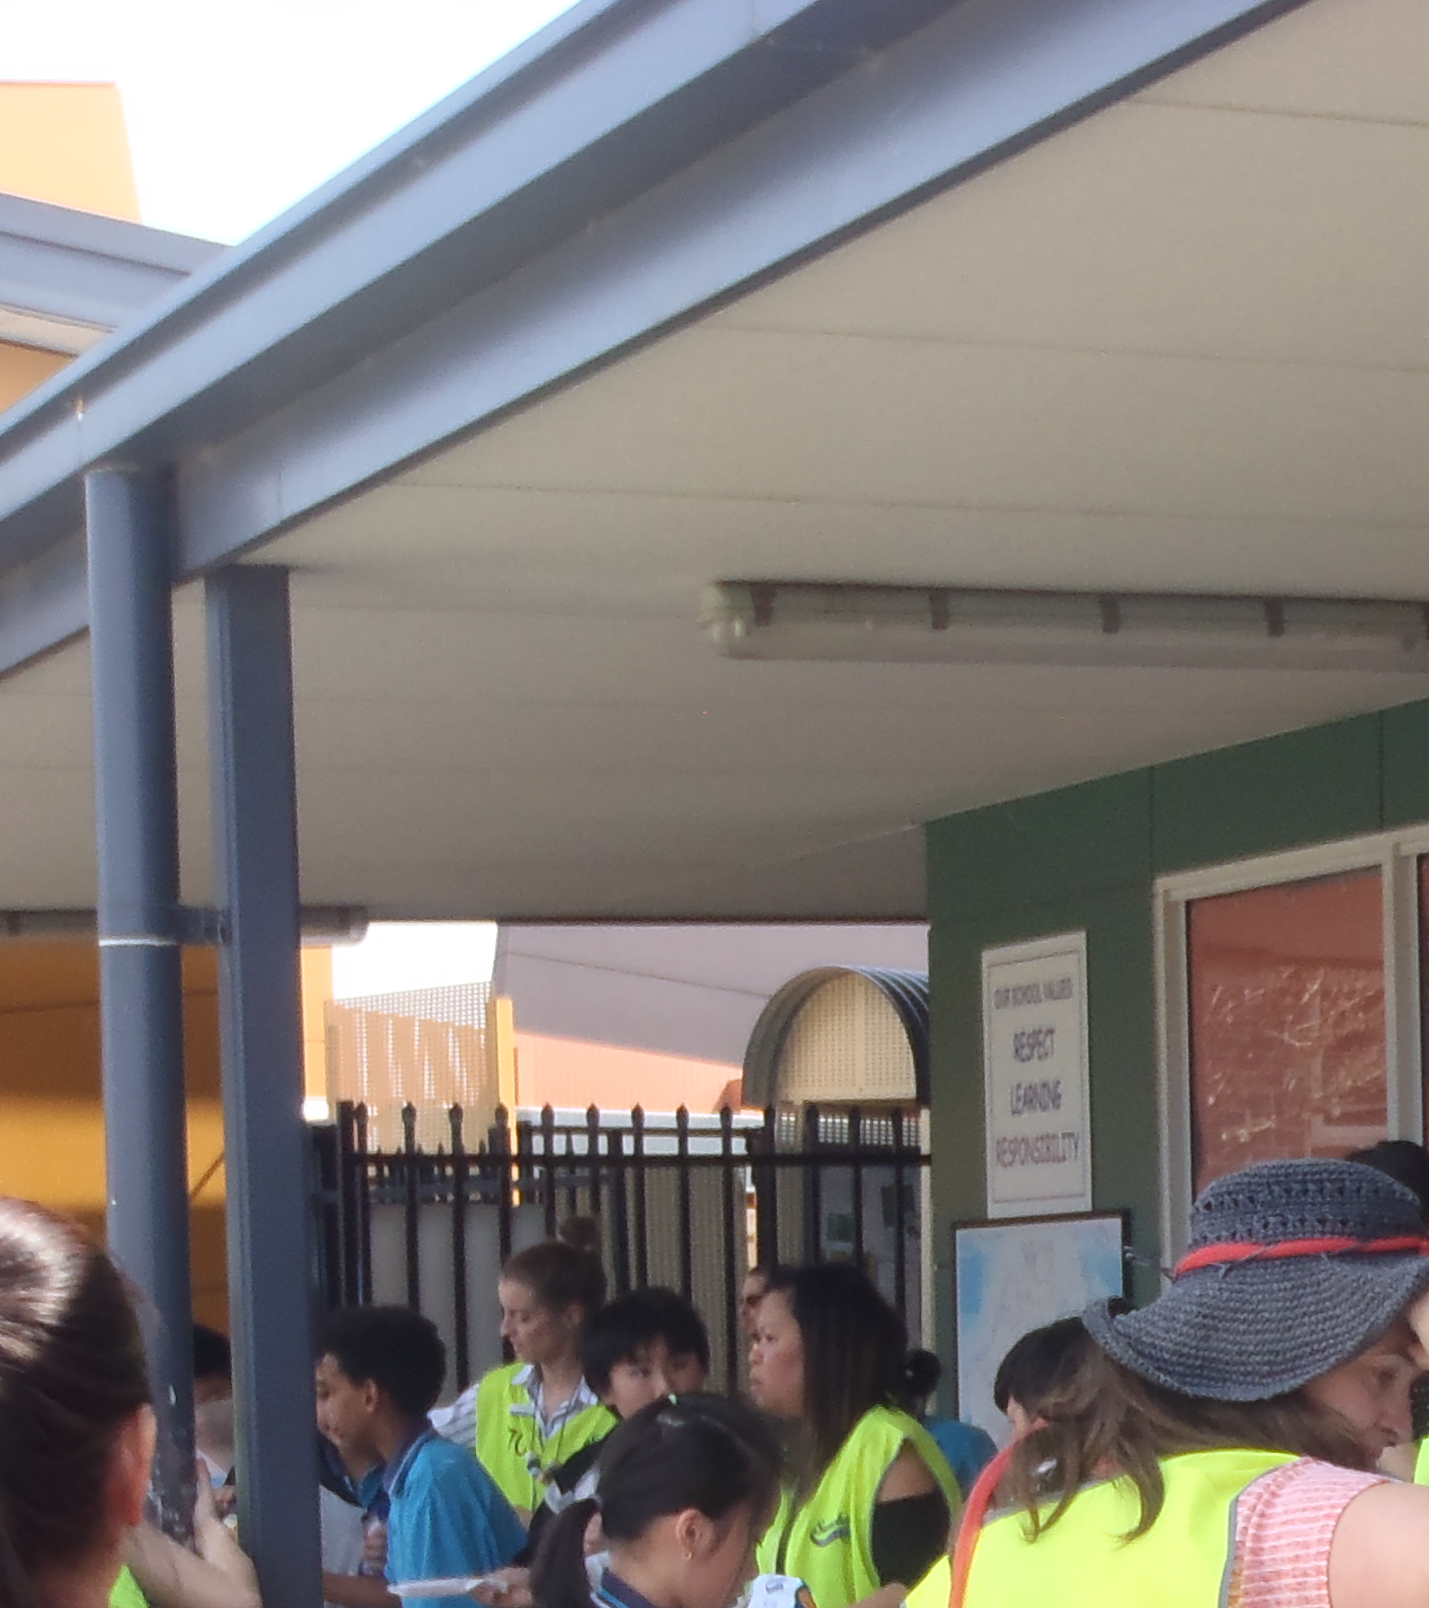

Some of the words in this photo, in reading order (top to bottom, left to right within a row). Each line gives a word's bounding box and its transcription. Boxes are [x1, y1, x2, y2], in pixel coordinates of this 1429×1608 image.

[1013, 1027, 1057, 1063] RESPECT
[1010, 1078, 1063, 1117] LEARNING
[996, 1131, 1081, 1169] RESPONSIBILITY
